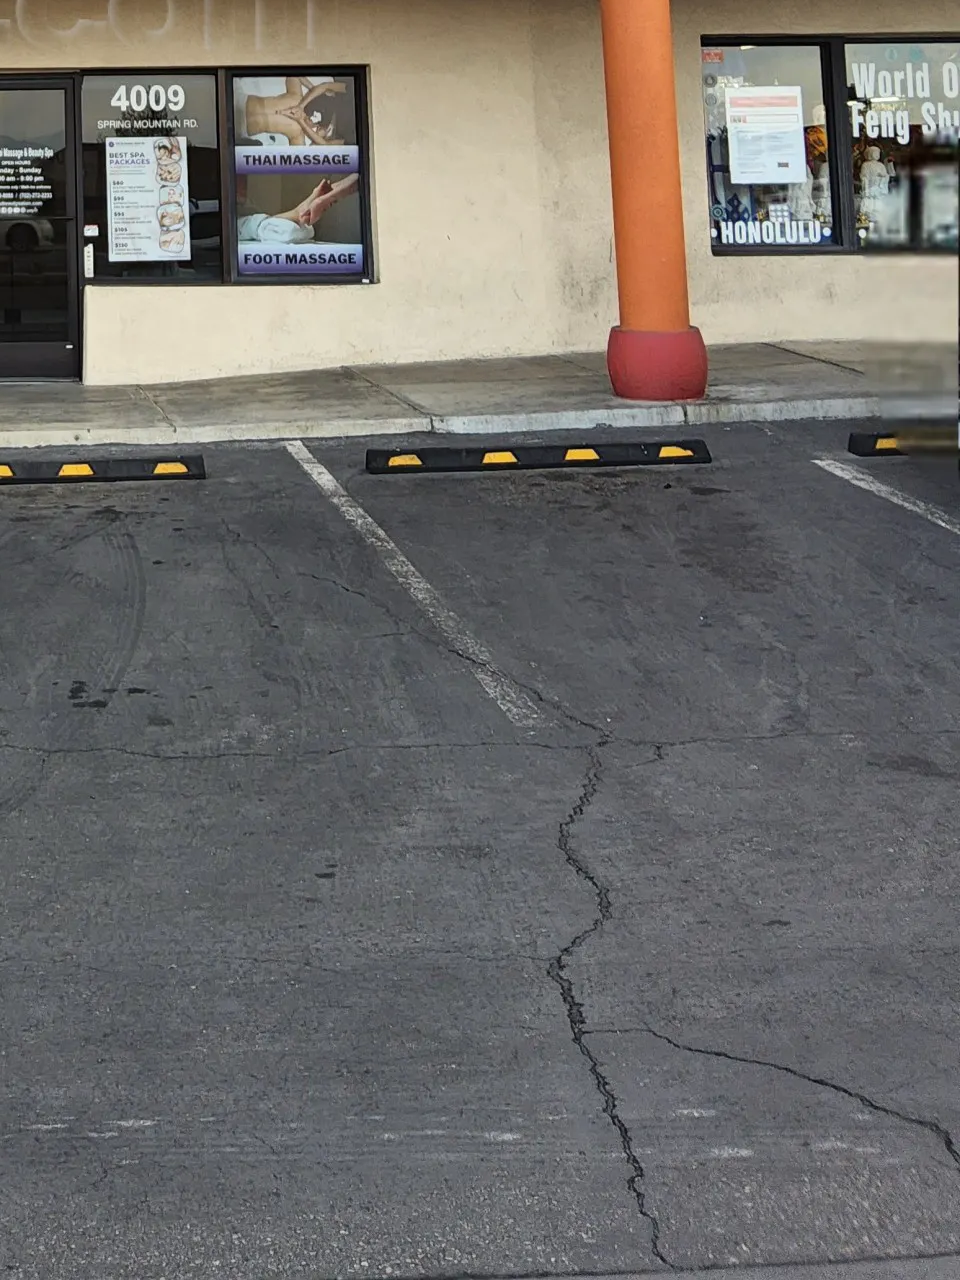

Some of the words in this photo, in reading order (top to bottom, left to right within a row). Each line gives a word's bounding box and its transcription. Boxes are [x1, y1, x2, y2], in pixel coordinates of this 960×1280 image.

[851, 62, 931, 98] World
[111, 84, 185, 111] 4009
[97, 120, 131, 129] SPRING
[133, 119, 181, 129] MOUNTAIN
[183, 119, 199, 128] RD.
[851, 102, 910, 145] Feng
[243, 154, 277, 166] THAI
[282, 154, 351, 166] MASSAGE
[721, 220, 821, 244] HONOLULU
[244, 254, 282, 265] FOOT
[285, 253, 357, 265] MASSAGE
